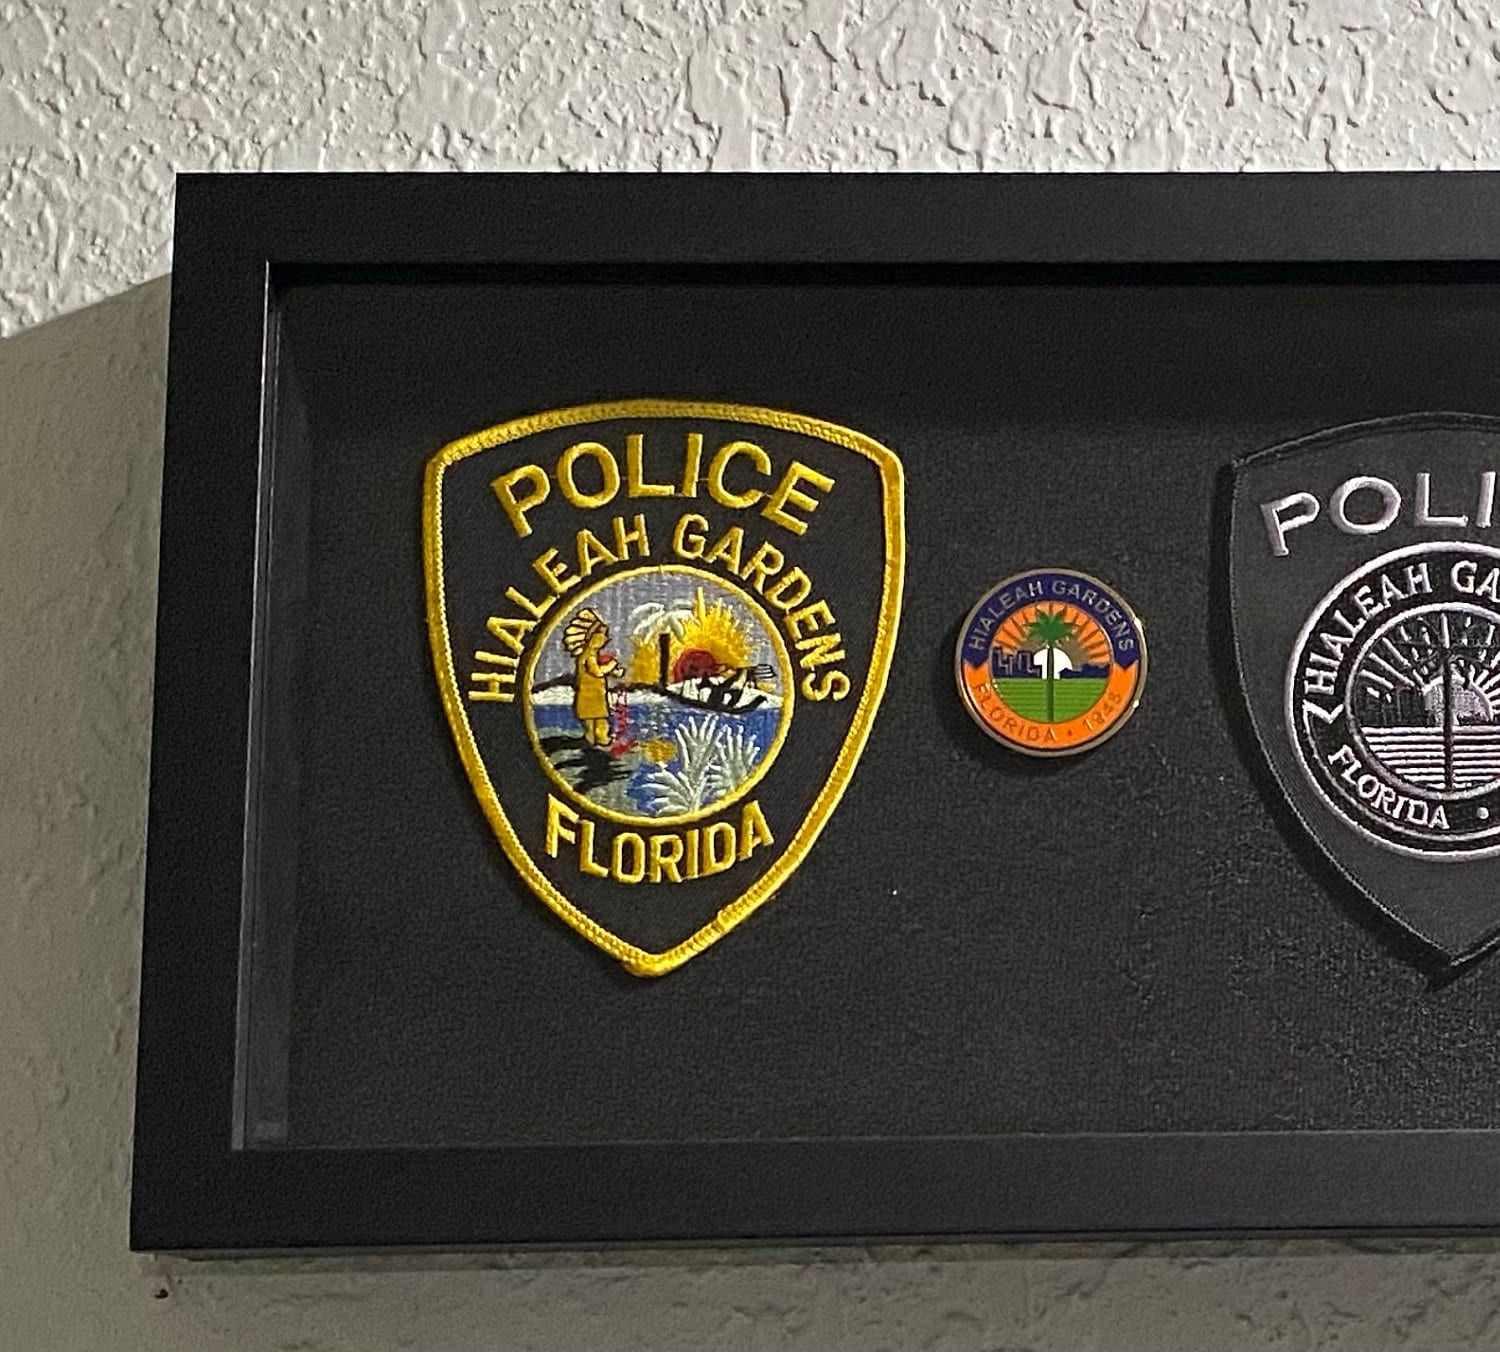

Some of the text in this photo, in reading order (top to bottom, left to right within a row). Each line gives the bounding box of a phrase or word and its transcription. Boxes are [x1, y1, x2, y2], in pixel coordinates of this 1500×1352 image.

[491, 433, 834, 538] POLICE
[469, 513, 851, 702] HIALEAH GARDENS
[969, 580, 1134, 651] HIALEAH GARDENS
[1303, 563, 1433, 695] HIALEAH
[973, 683, 1057, 741] FLORIDA
[1328, 744, 1450, 830] FLORIDA
[546, 794, 775, 883] FLORIDA
